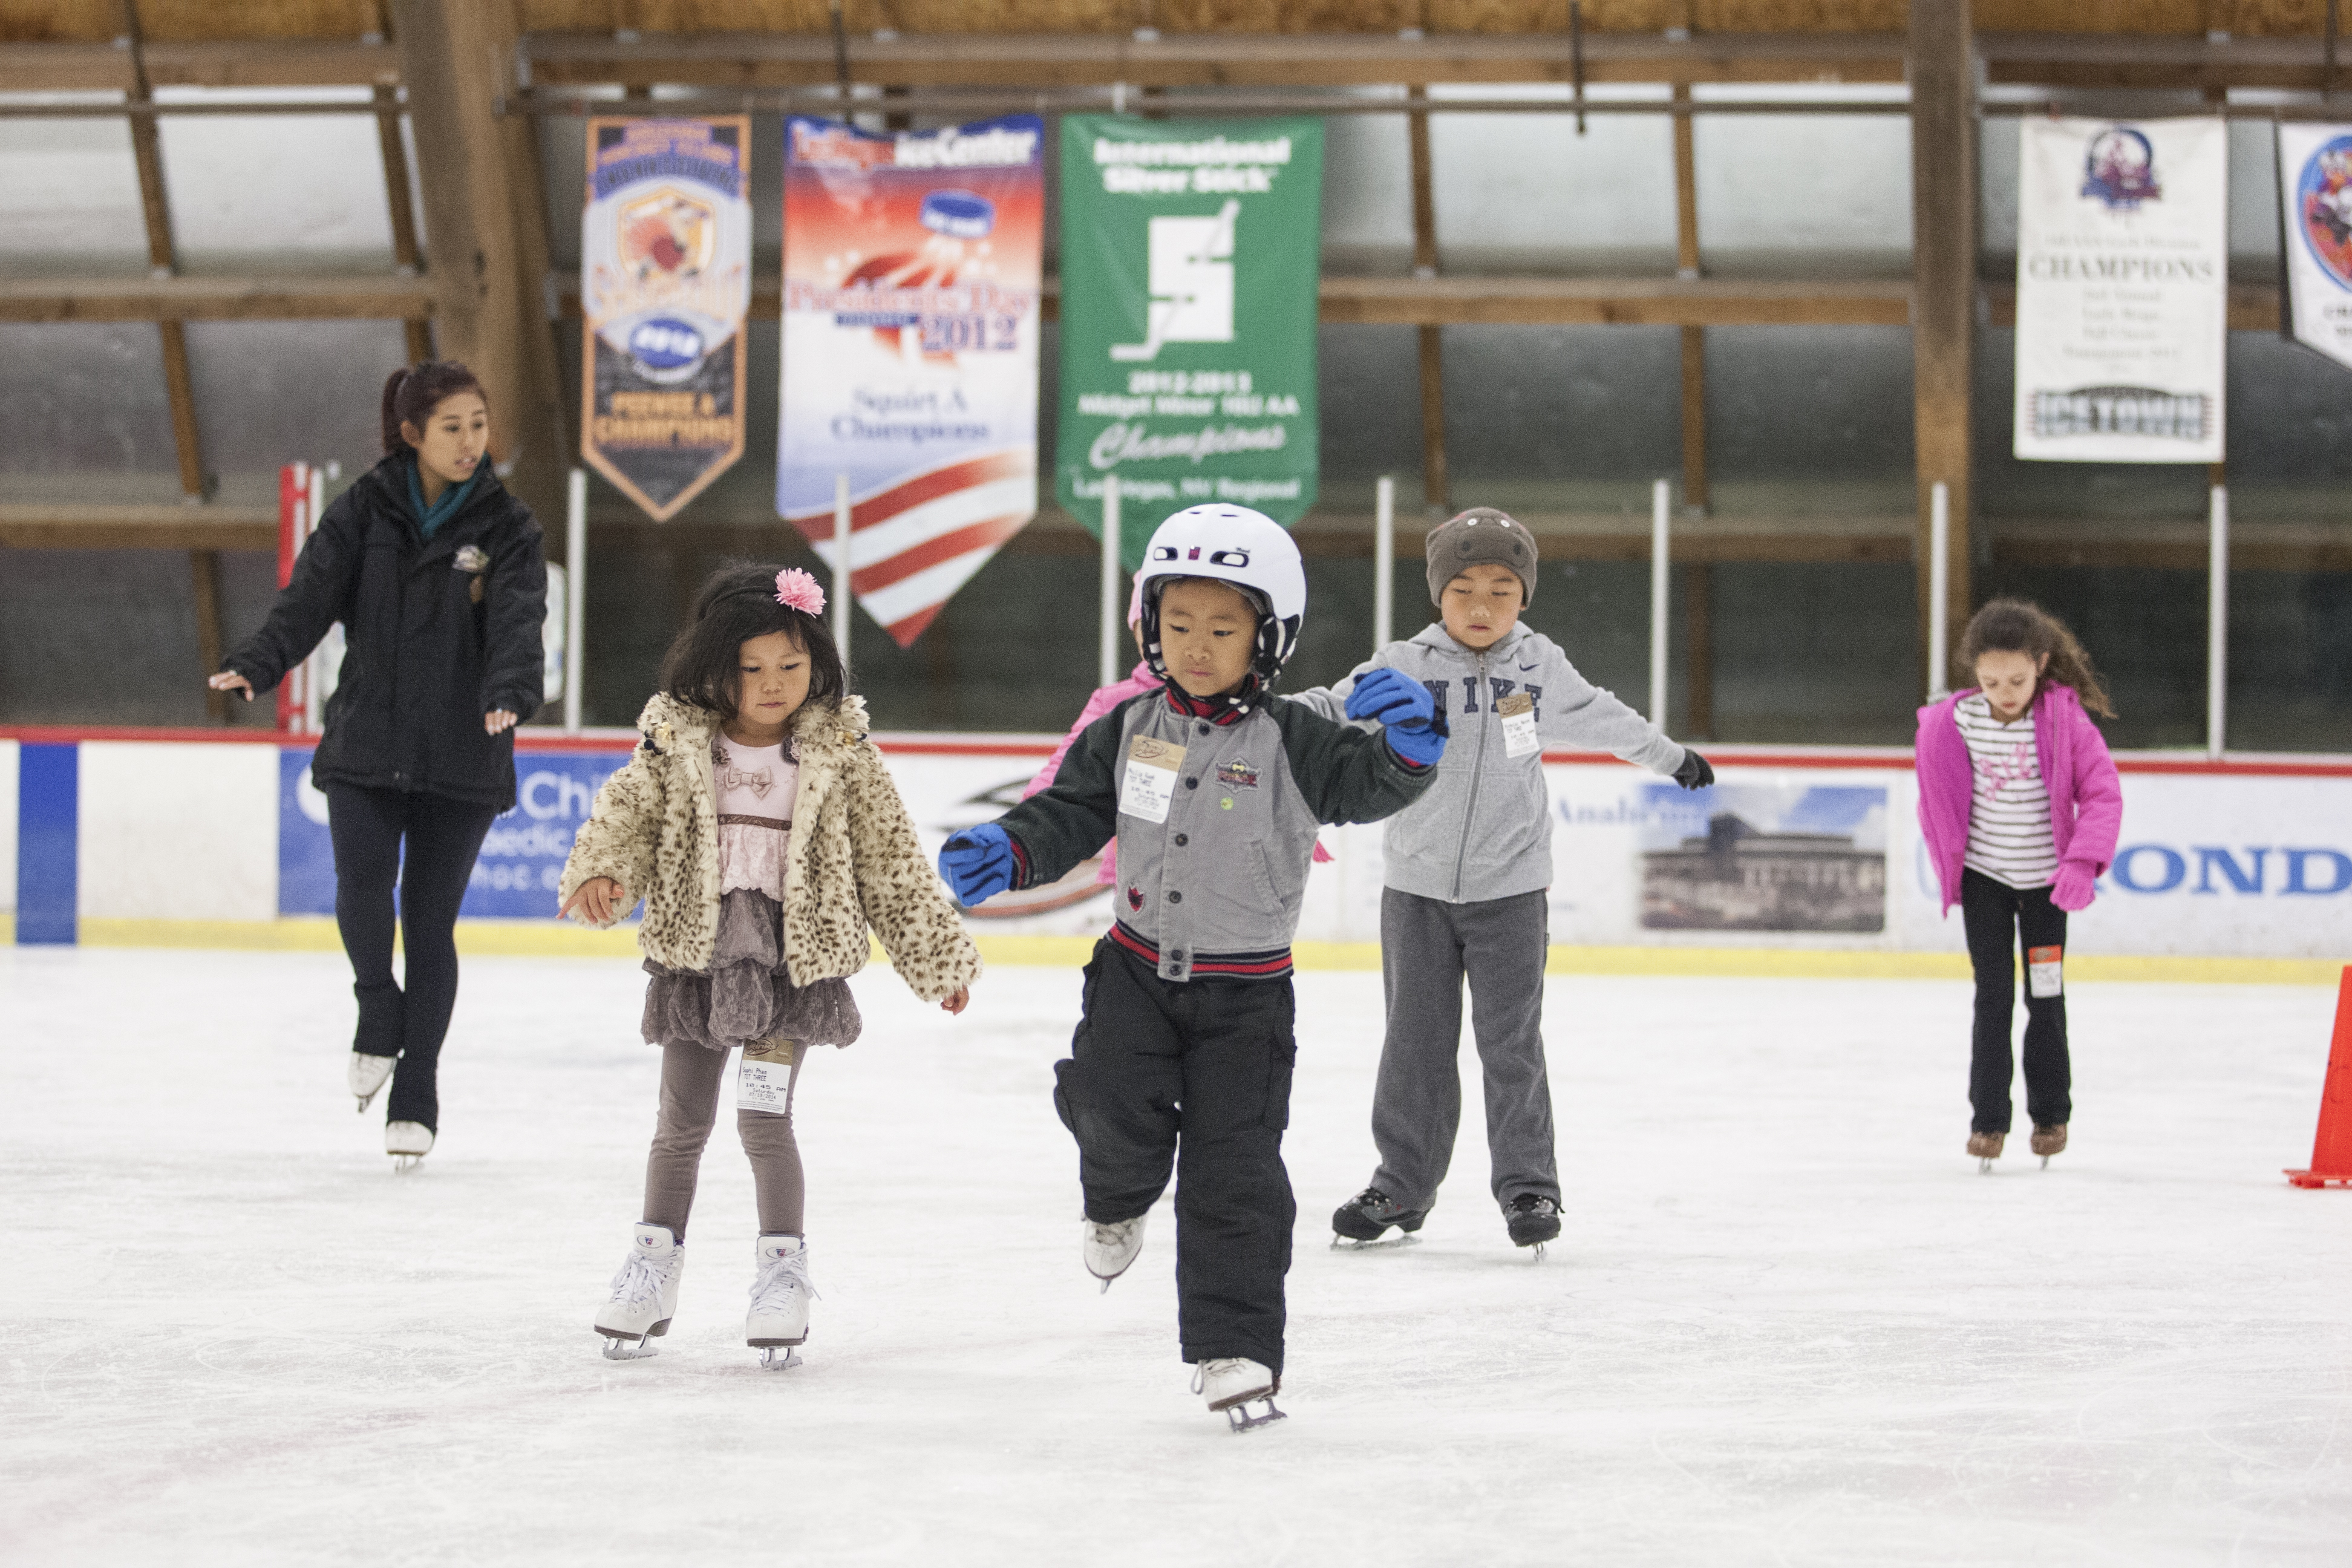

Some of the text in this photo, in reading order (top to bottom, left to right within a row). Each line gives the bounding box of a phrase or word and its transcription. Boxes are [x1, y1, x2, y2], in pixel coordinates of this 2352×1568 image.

[1094, 136, 1291, 165] International
[1104, 166, 1271, 193] Silver Stick
[2029, 255, 2212, 282] CHAMPIONS
[922, 314, 1017, 351] 2012
[854, 387, 969, 415] Squirt A
[1078, 395, 1151, 420] Midget
[1154, 395, 1215, 416] Minor
[1266, 396, 1301, 416] AA
[830, 415, 990, 446] Champions
[1090, 424, 1286, 470] Champions
[1216, 479, 1302, 502] Regional
